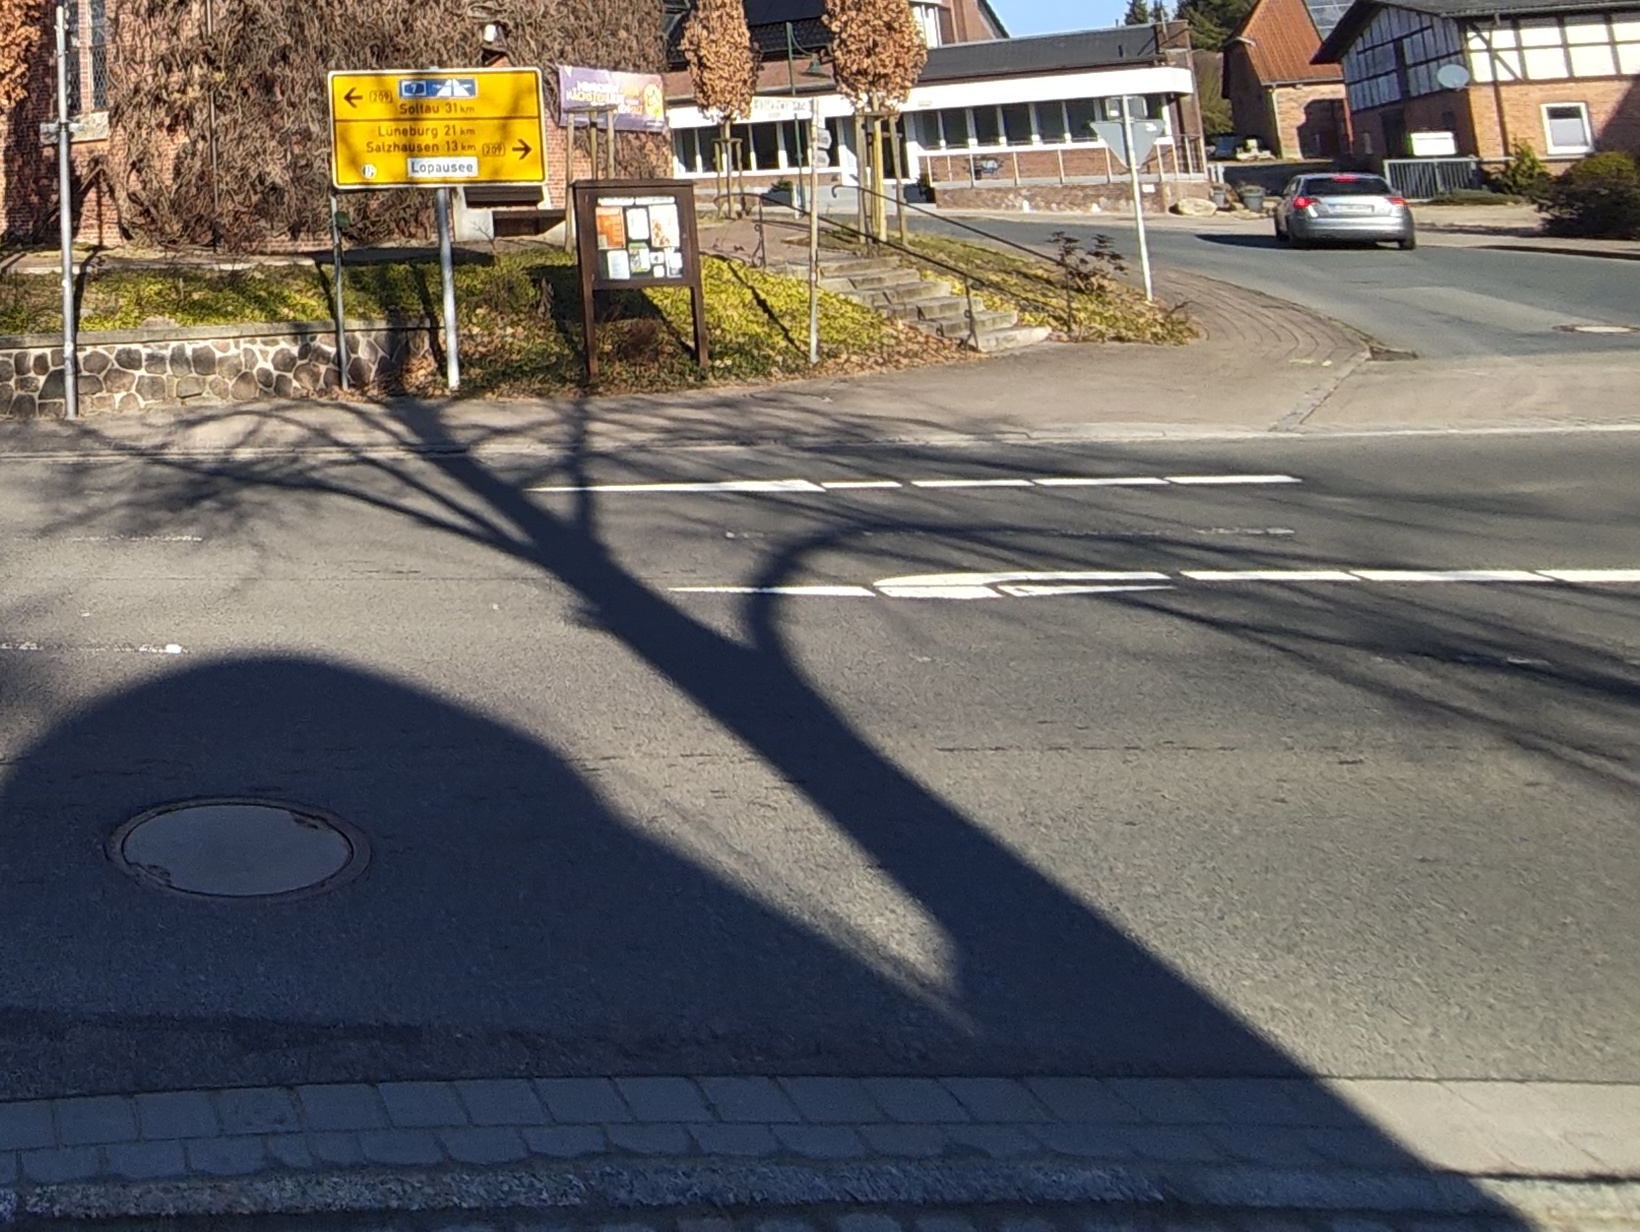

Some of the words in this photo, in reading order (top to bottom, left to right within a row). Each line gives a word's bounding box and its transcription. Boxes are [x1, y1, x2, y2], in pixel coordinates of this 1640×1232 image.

[399, 103, 439, 114] Soltau
[445, 102, 458, 113] 31
[378, 125, 438, 138] Lüneburg
[444, 125, 457, 136] 21
[366, 141, 439, 153] Salzhausen
[445, 141, 458, 152] 13
[461, 142, 476, 152] km
[411, 161, 474, 175] Lopausee
